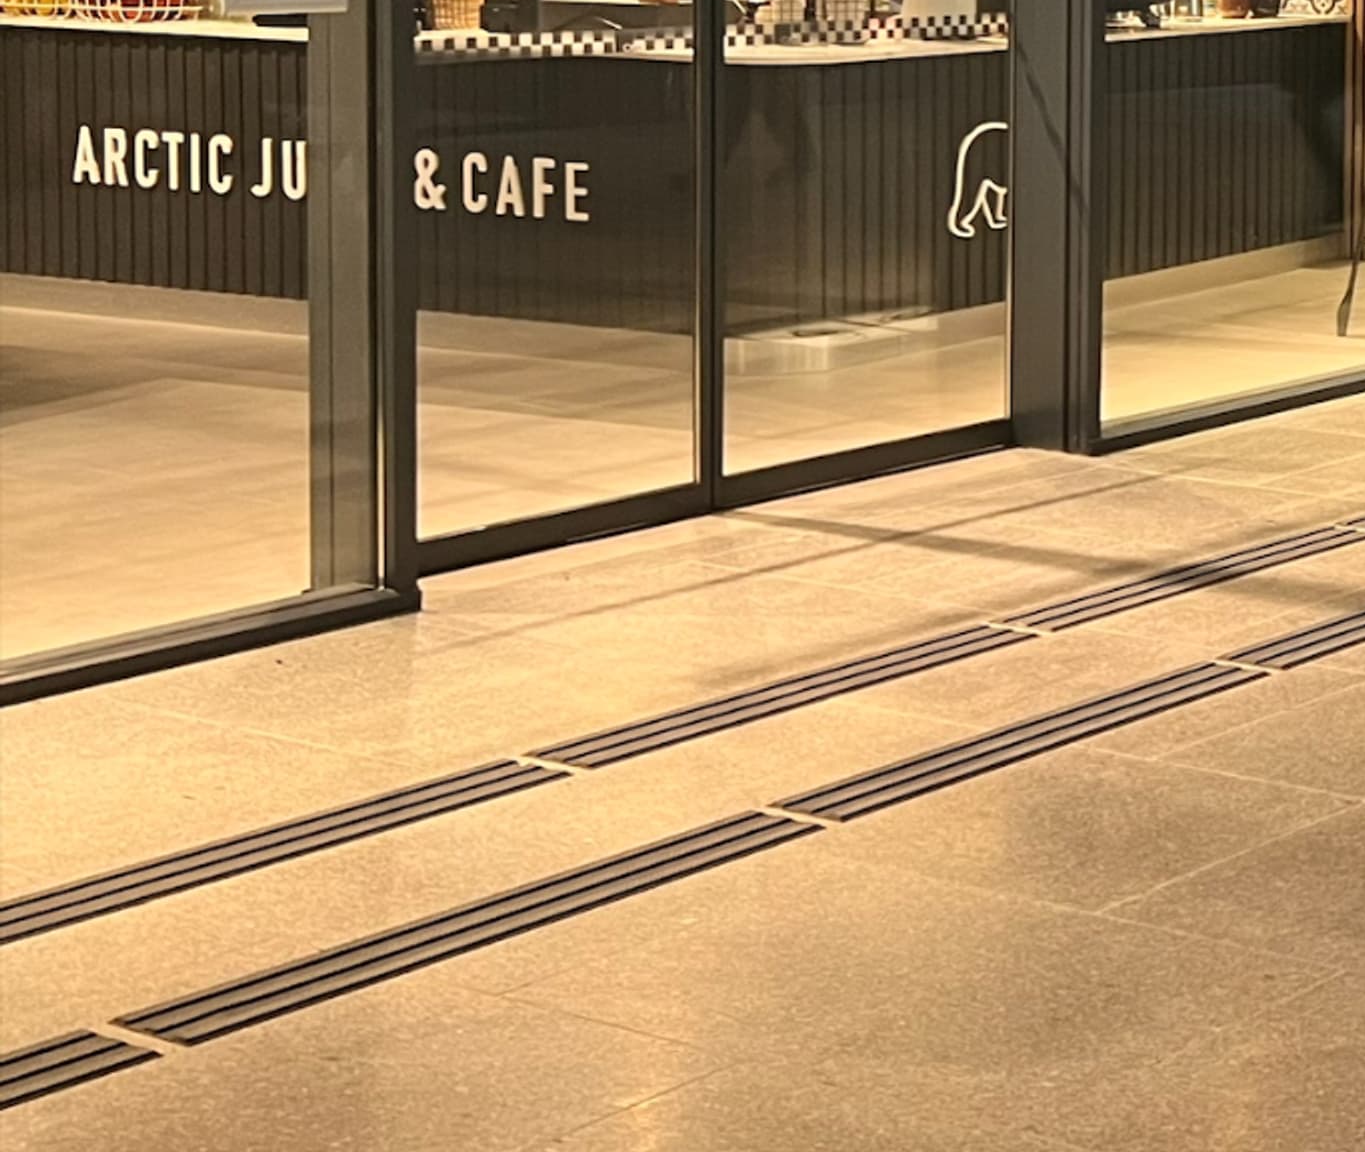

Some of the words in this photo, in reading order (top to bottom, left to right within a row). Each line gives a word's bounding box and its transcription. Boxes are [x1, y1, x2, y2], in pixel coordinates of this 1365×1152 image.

[73, 125, 233, 195] ARCTIC
[413, 148, 447, 211] &
[462, 151, 590, 222] CAFE
